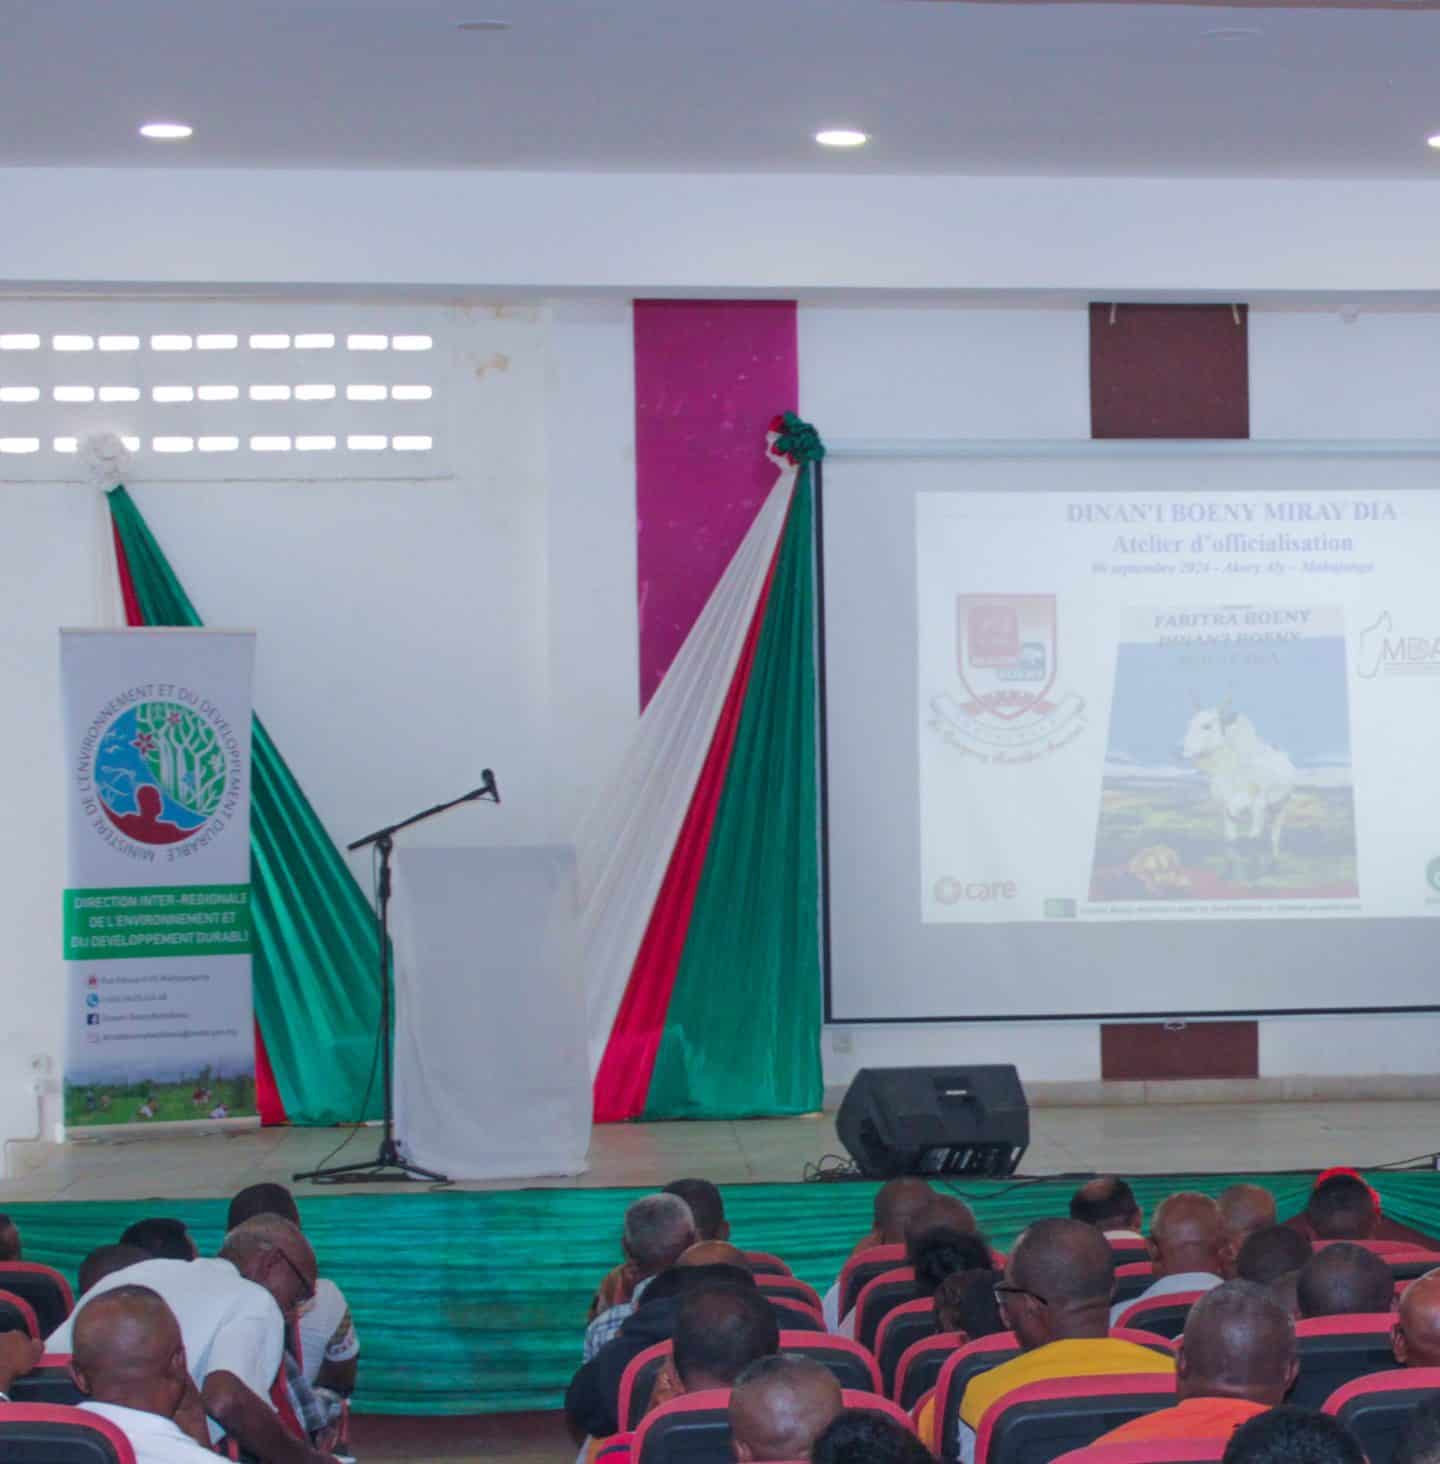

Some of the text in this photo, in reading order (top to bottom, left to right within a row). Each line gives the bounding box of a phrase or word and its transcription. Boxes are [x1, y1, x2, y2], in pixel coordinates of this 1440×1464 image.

[1067, 501, 1397, 520] DINAN'I BOENY MIRAY DIA
[1112, 531, 1354, 552] Atelier d'officialisation
[159, 684, 176, 697] ET
[965, 880, 1017, 901] care
[222, 911, 236, 924] ET
